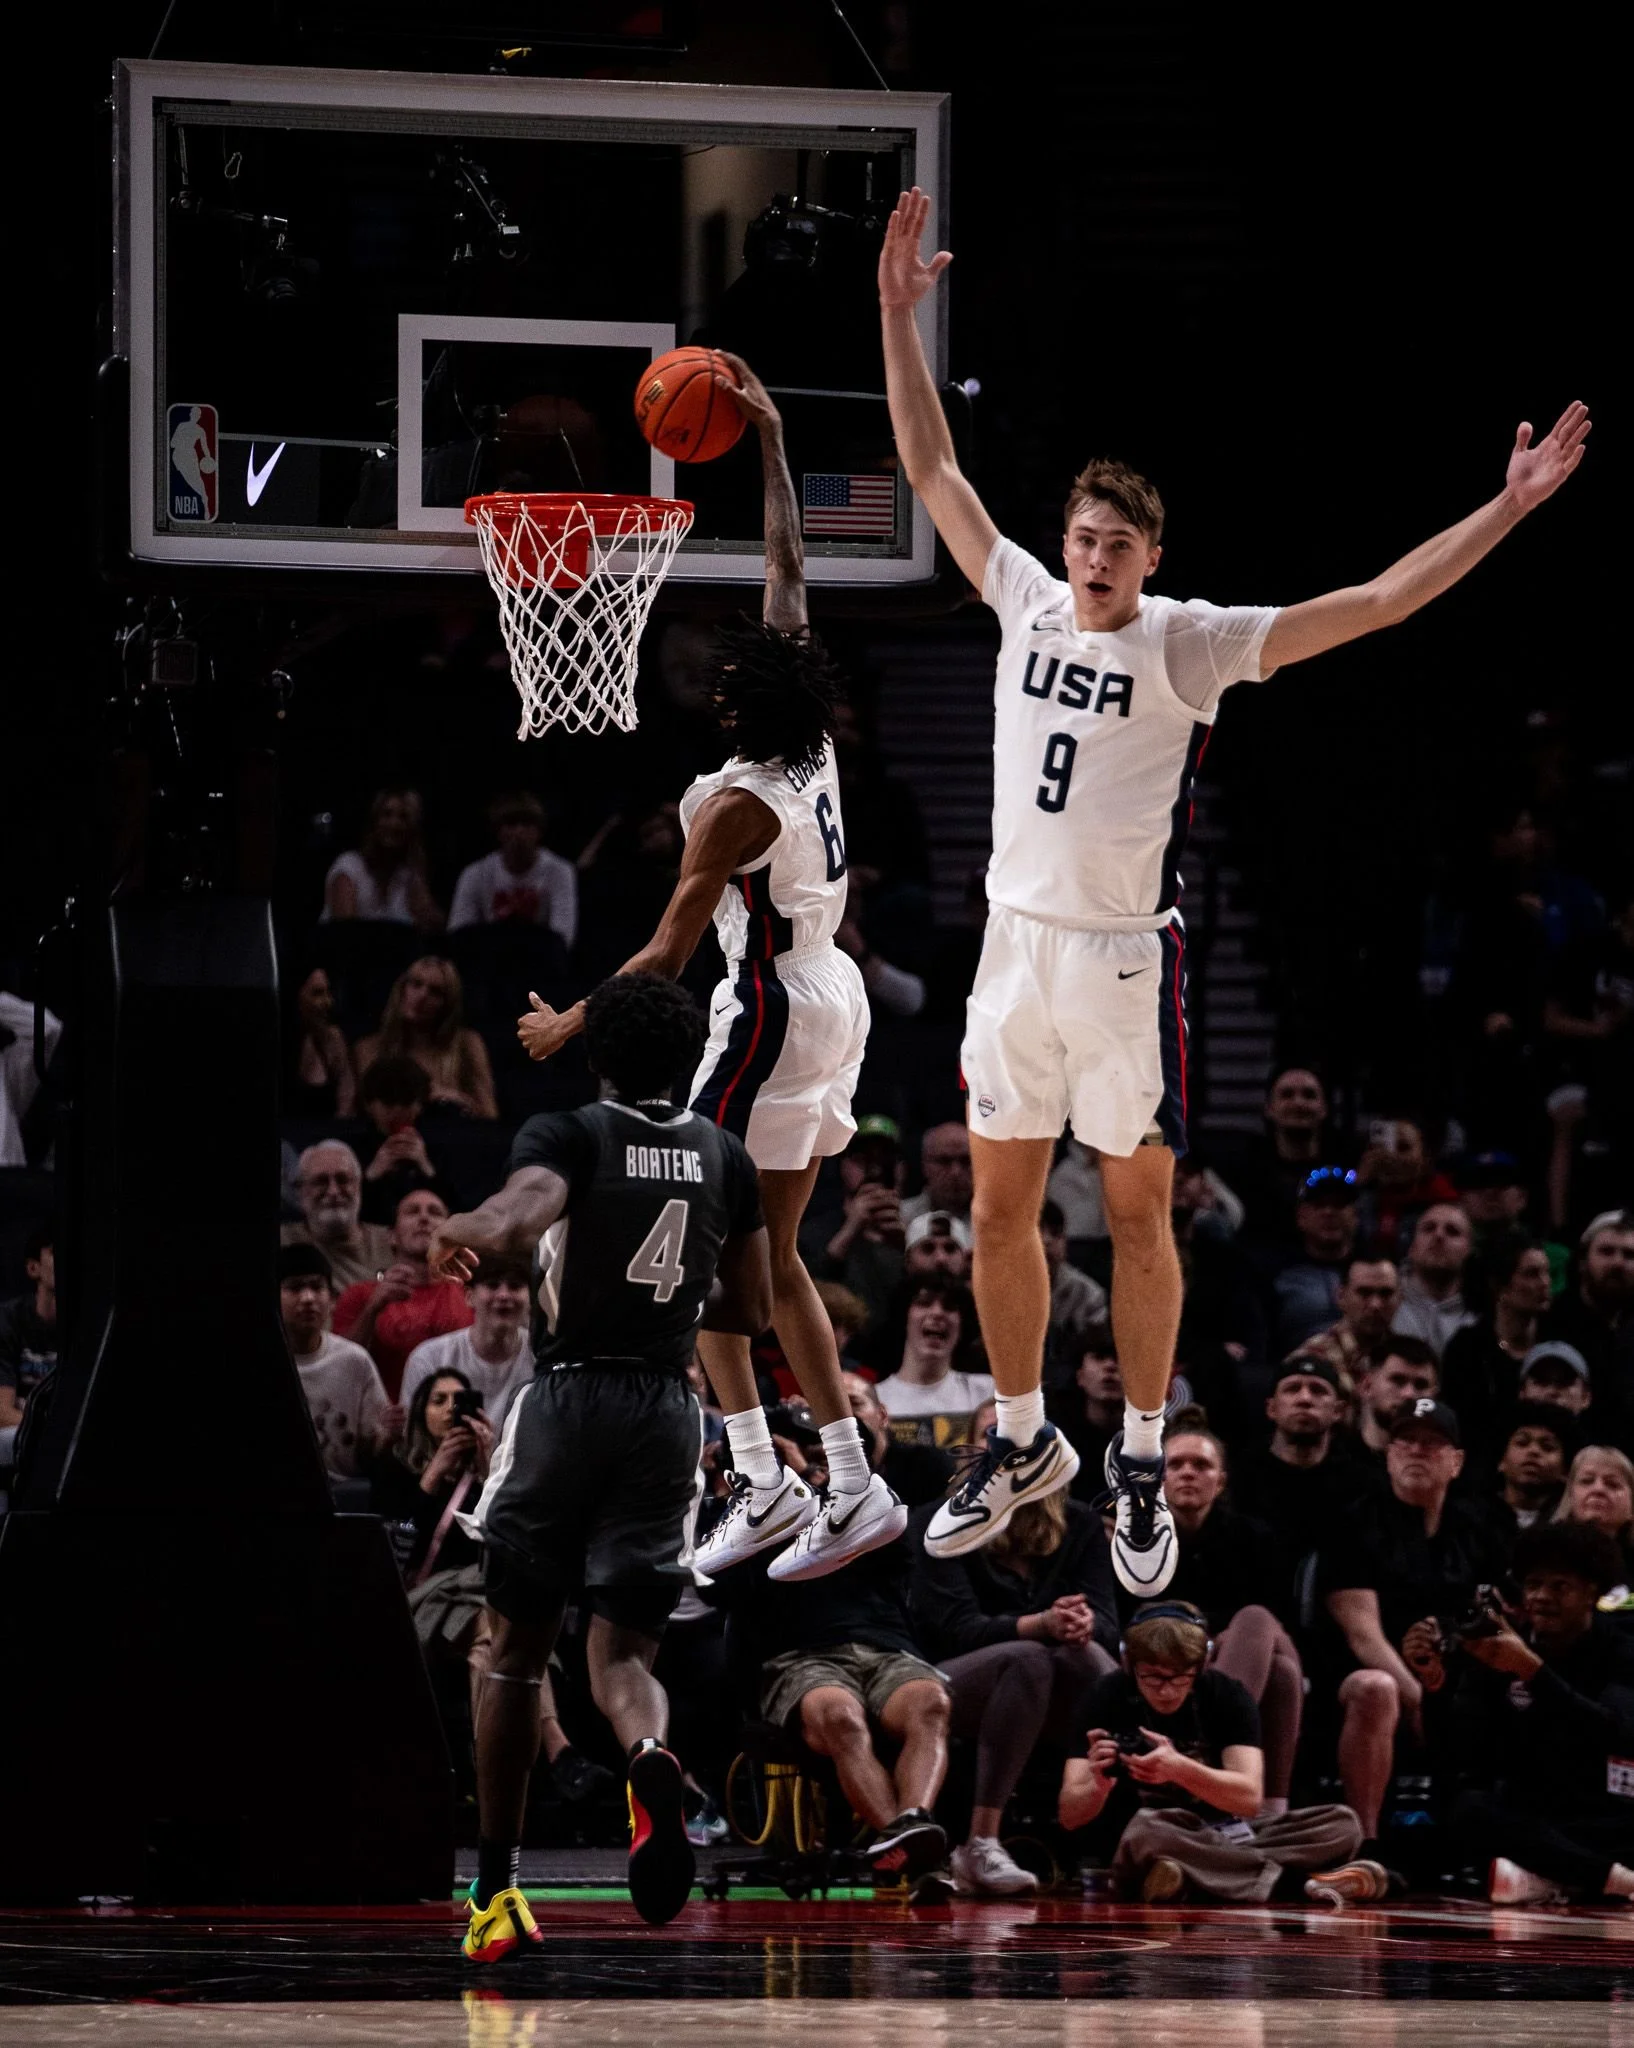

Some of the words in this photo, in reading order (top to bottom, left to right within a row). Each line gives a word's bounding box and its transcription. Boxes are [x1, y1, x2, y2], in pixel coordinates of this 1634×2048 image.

[175, 496, 199, 514] NBA
[1022, 651, 1134, 717] USA
[784, 750, 827, 794] EVANS
[1036, 731, 1078, 813] 9
[815, 792, 846, 882] 6
[626, 1145, 703, 1183] BOATENG
[626, 1198, 688, 1302] 4
[1413, 1398, 1437, 1418] P
